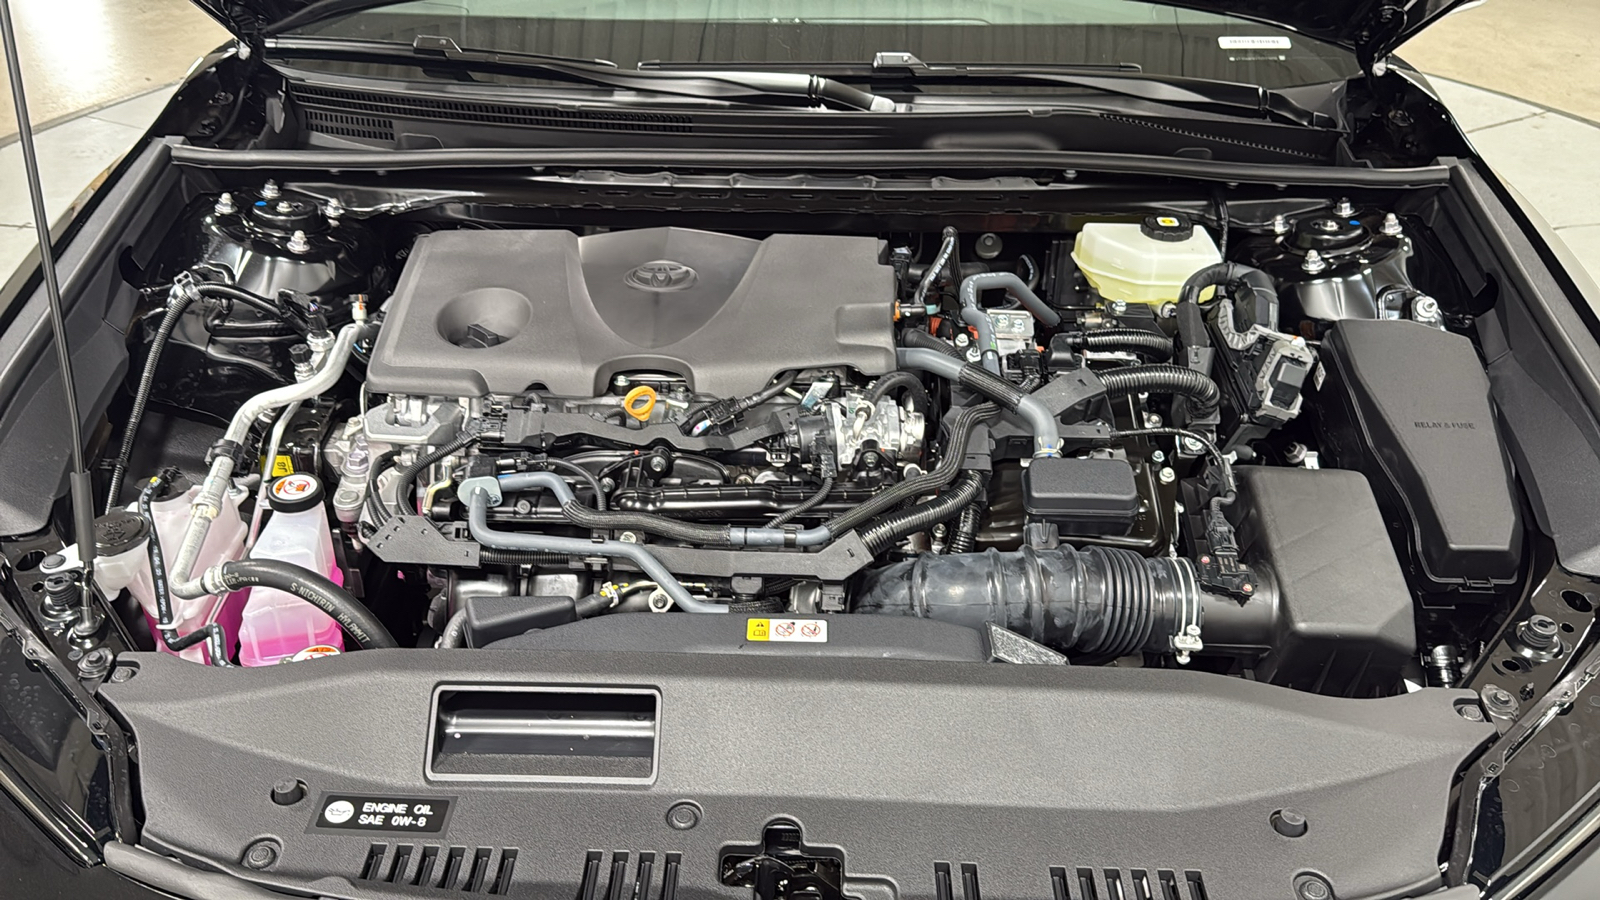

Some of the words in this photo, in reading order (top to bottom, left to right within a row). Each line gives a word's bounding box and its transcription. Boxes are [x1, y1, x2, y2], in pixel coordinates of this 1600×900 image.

[362, 802, 408, 814] ENGINE
[413, 804, 434, 815] OIL
[358, 814, 385, 825] SAE
[391, 816, 427, 827] 0W-8
